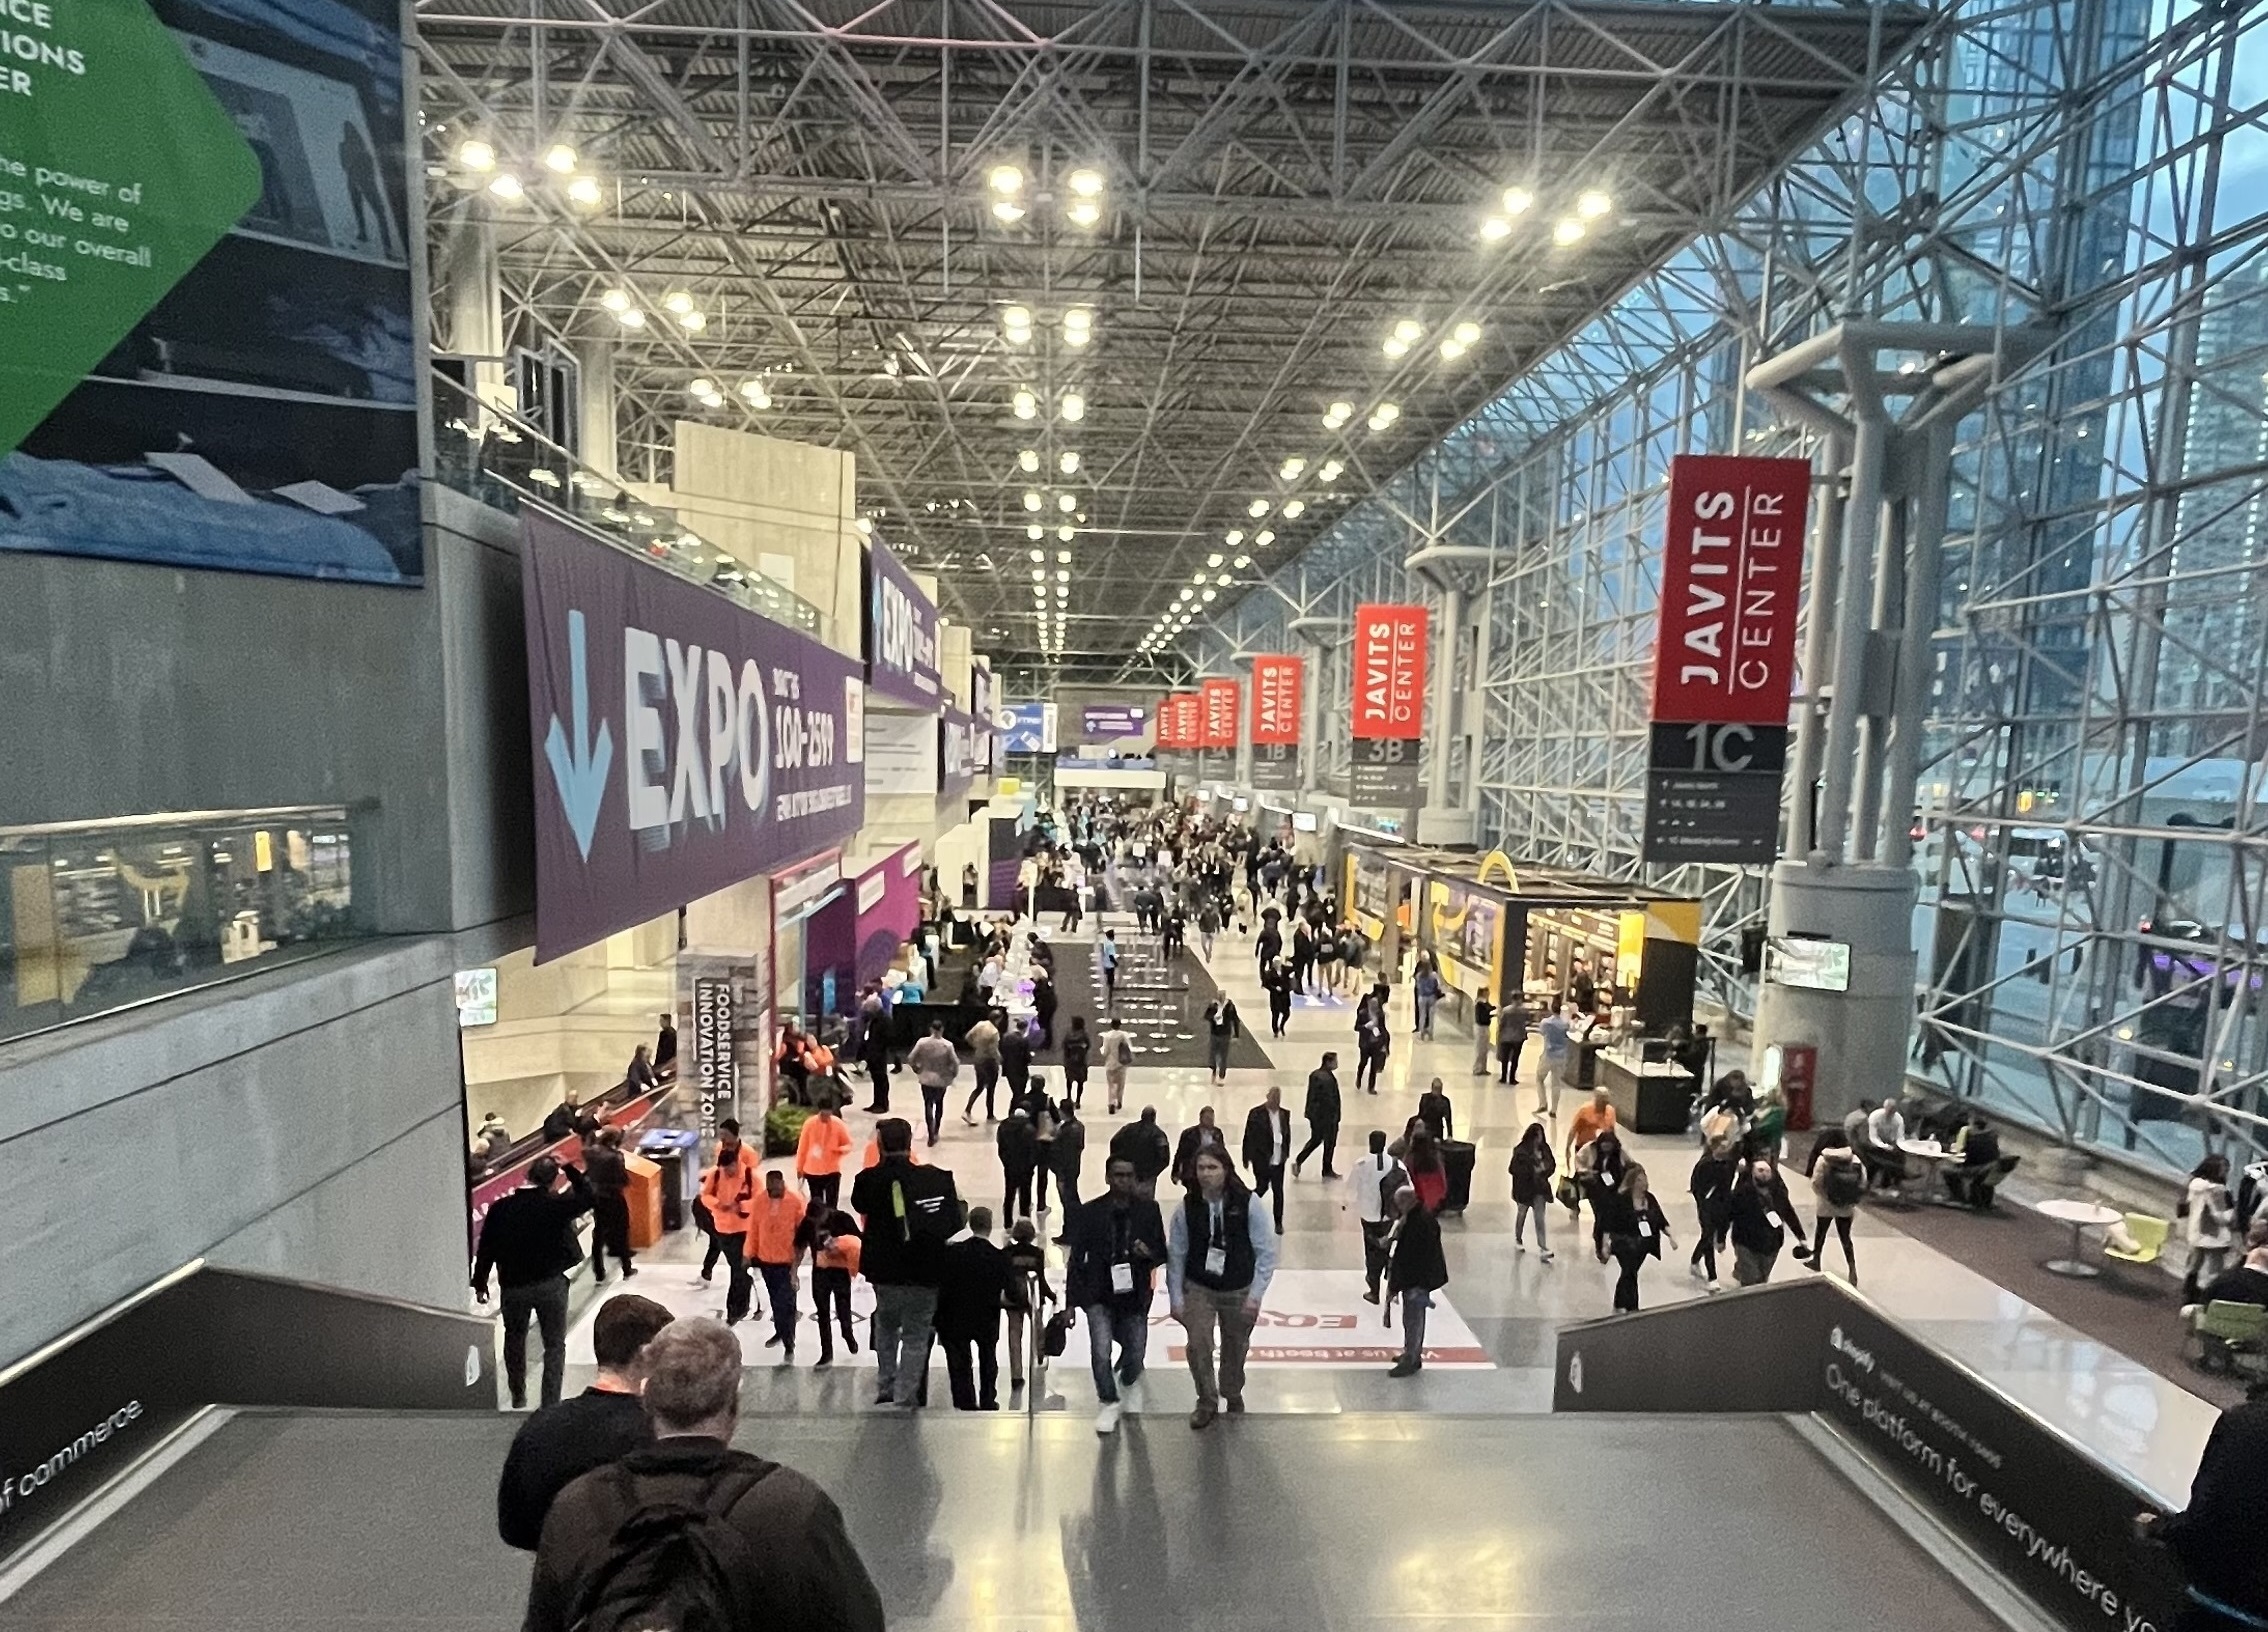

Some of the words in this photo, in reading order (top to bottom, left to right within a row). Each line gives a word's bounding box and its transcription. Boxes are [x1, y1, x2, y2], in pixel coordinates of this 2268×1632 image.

[0, 29, 87, 75] IONS
[35, 167, 110, 196] power
[118, 182, 143, 205] of
[41, 193, 84, 223] We
[91, 212, 129, 234] are
[25, 229, 67, 249] our
[74, 239, 152, 269] overall
[1680, 490, 1735, 686] JAVITS
[1738, 492, 1784, 690] CENTER
[1260, 666, 1278, 732] JAVITS
[1280, 666, 1294, 733] CENTER
[1364, 622, 1391, 721] JAVITS
[1394, 622, 1417, 722] CENTER
[624, 626, 769, 831] EXPO
[1208, 688, 1222, 738] JAVITS
[1264, 743, 1287, 761] 1B
[1368, 737, 1404, 763] 3B
[1685, 722, 1756, 772] 1C
[699, 982, 715, 1089] INNOVATION
[715, 983, 732, 1100] FOODSERVICE
[0, 1477, 15, 1515] f
[19, 1399, 144, 1497] commerce
[1826, 1363, 1862, 1407] One
[1862, 1398, 1942, 1476] platform
[1947, 1457, 1979, 1499] for
[1979, 1492, 2119, 1617] everywhere
